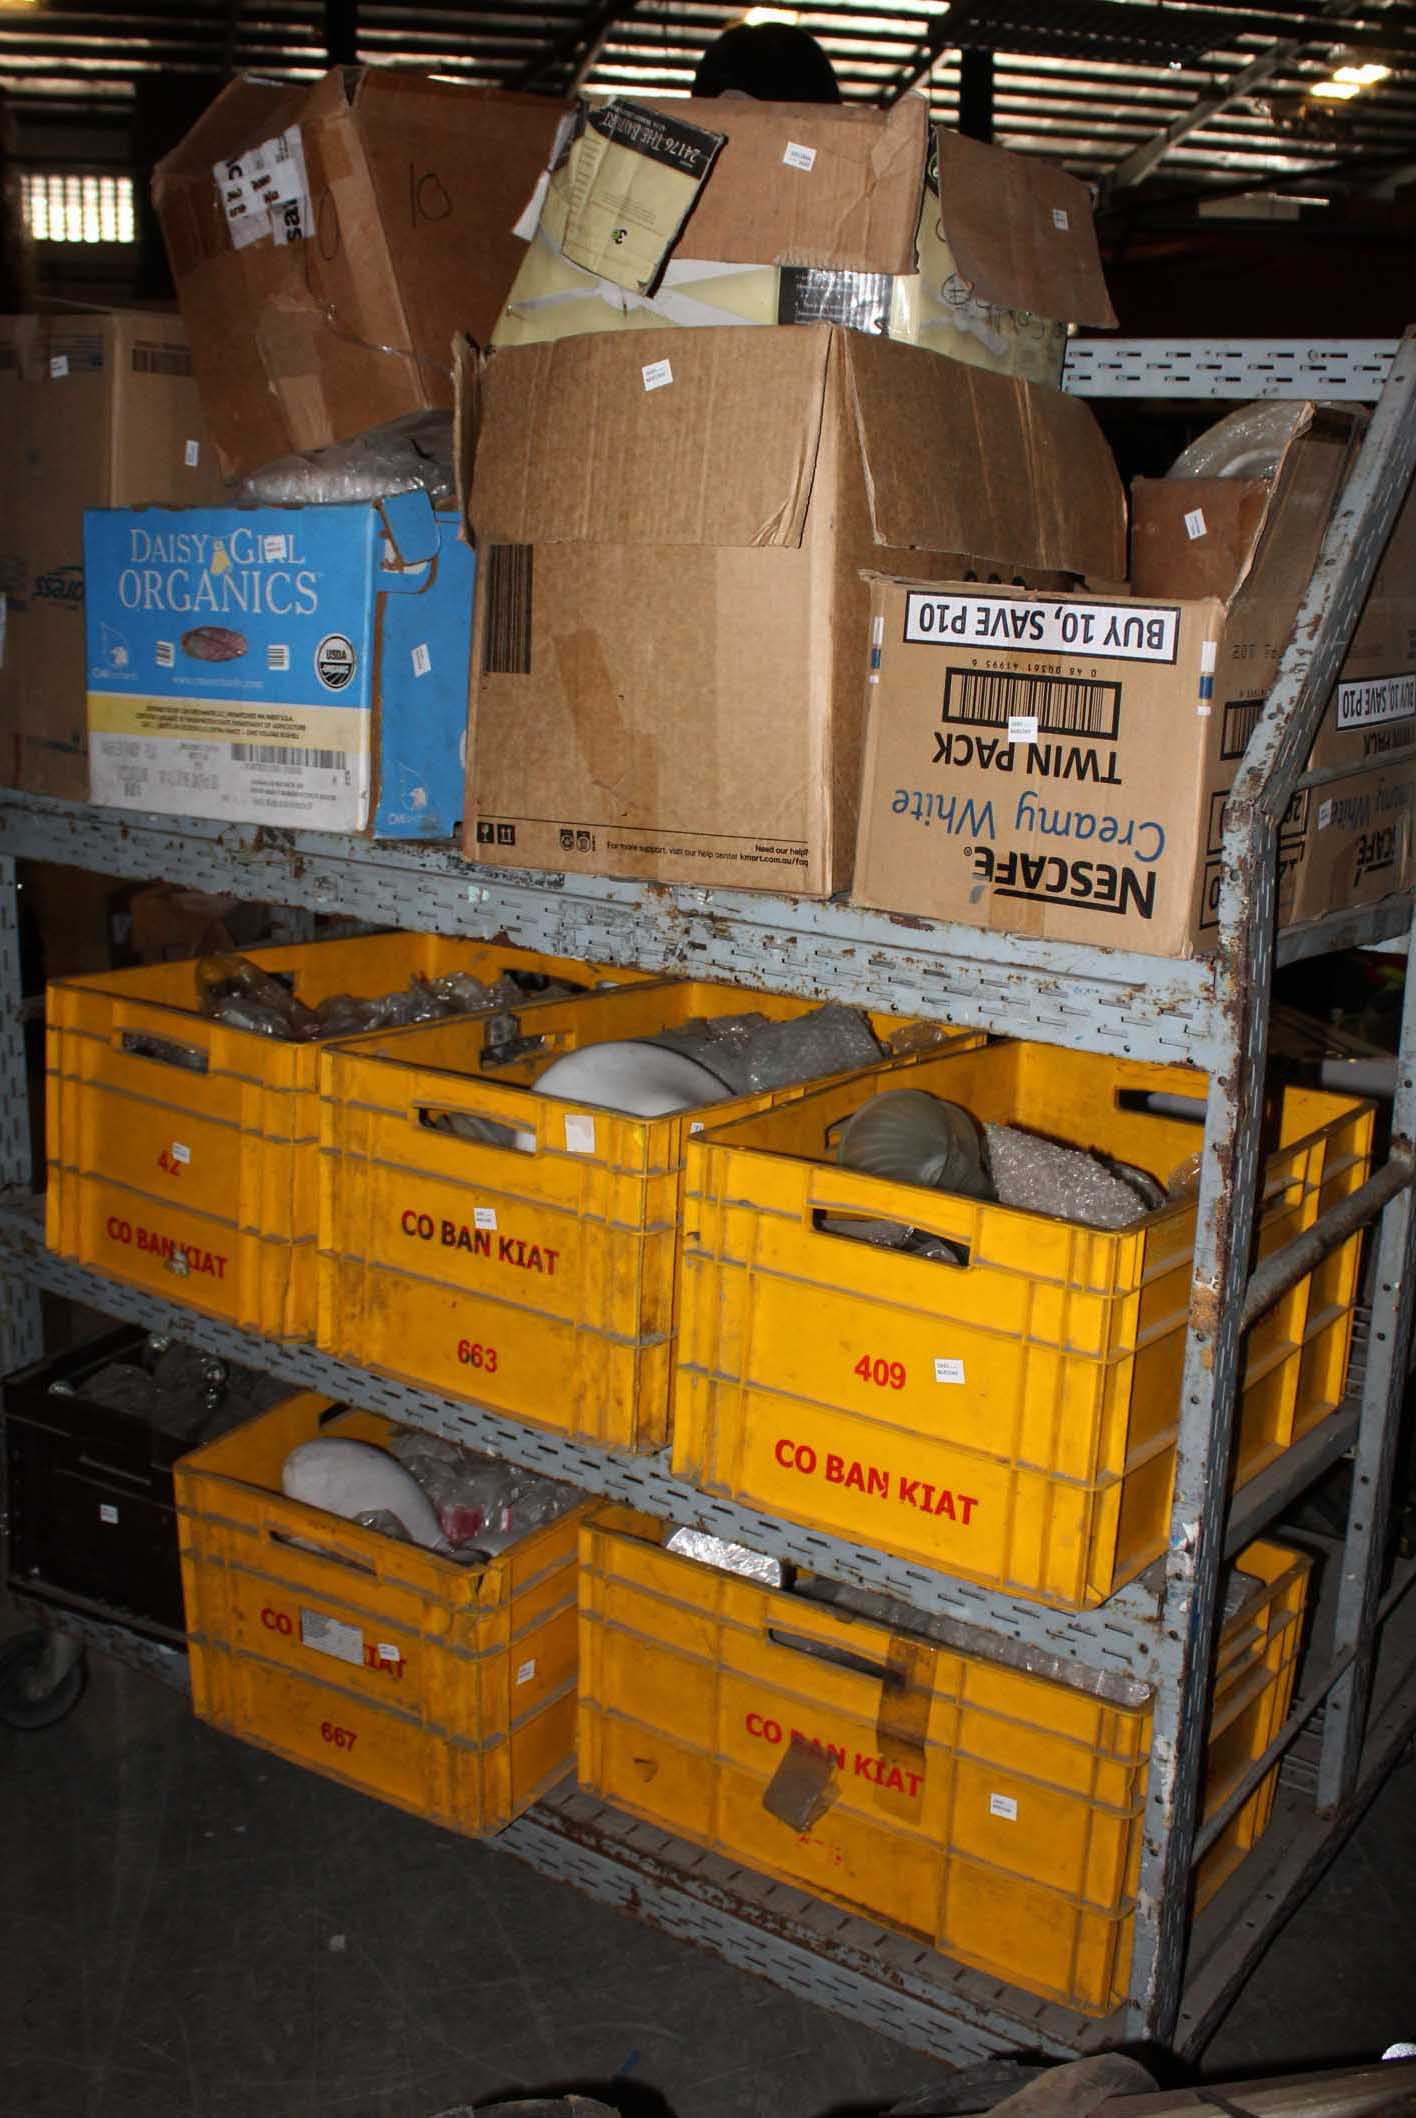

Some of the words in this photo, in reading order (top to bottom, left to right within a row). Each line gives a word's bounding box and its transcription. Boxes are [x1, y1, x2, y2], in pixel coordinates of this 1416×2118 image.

[128, 528, 209, 563] DAISY
[230, 527, 306, 565] GIL
[118, 567, 319, 615] ORGANICS
[919, 602, 967, 634] P10
[975, 606, 1045, 640] SAVE
[1054, 606, 1096, 644] 10,
[1103, 615, 1164, 649] BUY
[1342, 689, 1362, 718] P10
[1364, 688, 1387, 716] SAVE
[931, 732, 1016, 771] PACK
[1026, 742, 1122, 784] TWIN
[891, 788, 996, 840] White
[1015, 790, 1166, 863] Creamy
[755, 843, 774, 853] Need
[775, 846, 788, 854] our
[107, 1216, 132, 1244] CO
[136, 1227, 175, 1258] BAN
[401, 1209, 435, 1240] CO
[441, 1219, 491, 1258] BAN
[498, 1235, 560, 1276] KIAT
[457, 1339, 498, 1373] 663
[854, 1354, 906, 1390] 409
[774, 1439, 817, 1475] CO
[825, 1453, 890, 1499] BAN
[898, 1477, 979, 1526] KIAT
[260, 1607, 293, 1636] CO
[321, 1721, 358, 1752] 667
[745, 1712, 782, 1744] CO
[853, 1753, 925, 1798] KIAT
